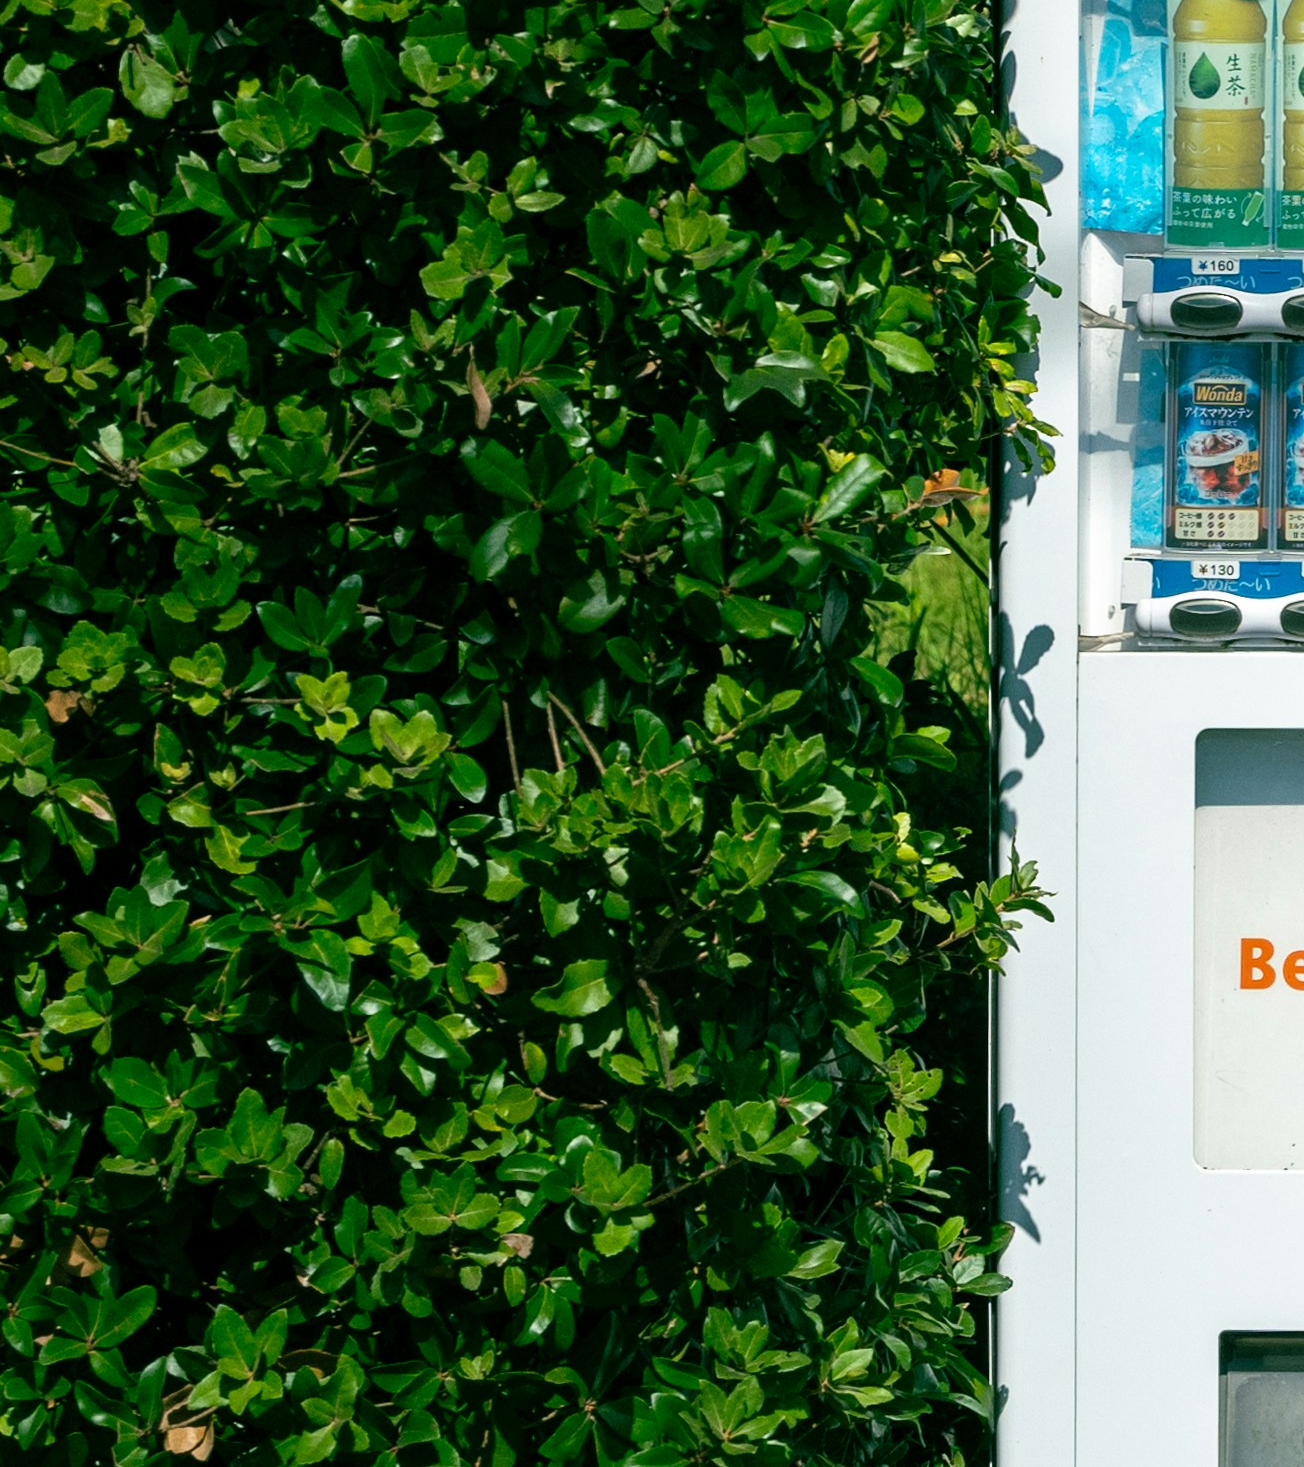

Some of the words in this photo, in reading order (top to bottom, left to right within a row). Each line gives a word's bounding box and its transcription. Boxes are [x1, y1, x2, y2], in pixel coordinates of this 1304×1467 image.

[1225, 53, 1247, 98] 生茶
[1198, 259, 1235, 272] ¥160
[1196, 385, 1244, 403] Wonda
[1184, 406, 1255, 419] アイスマウンテン
[1199, 564, 1236, 577] ¥130
